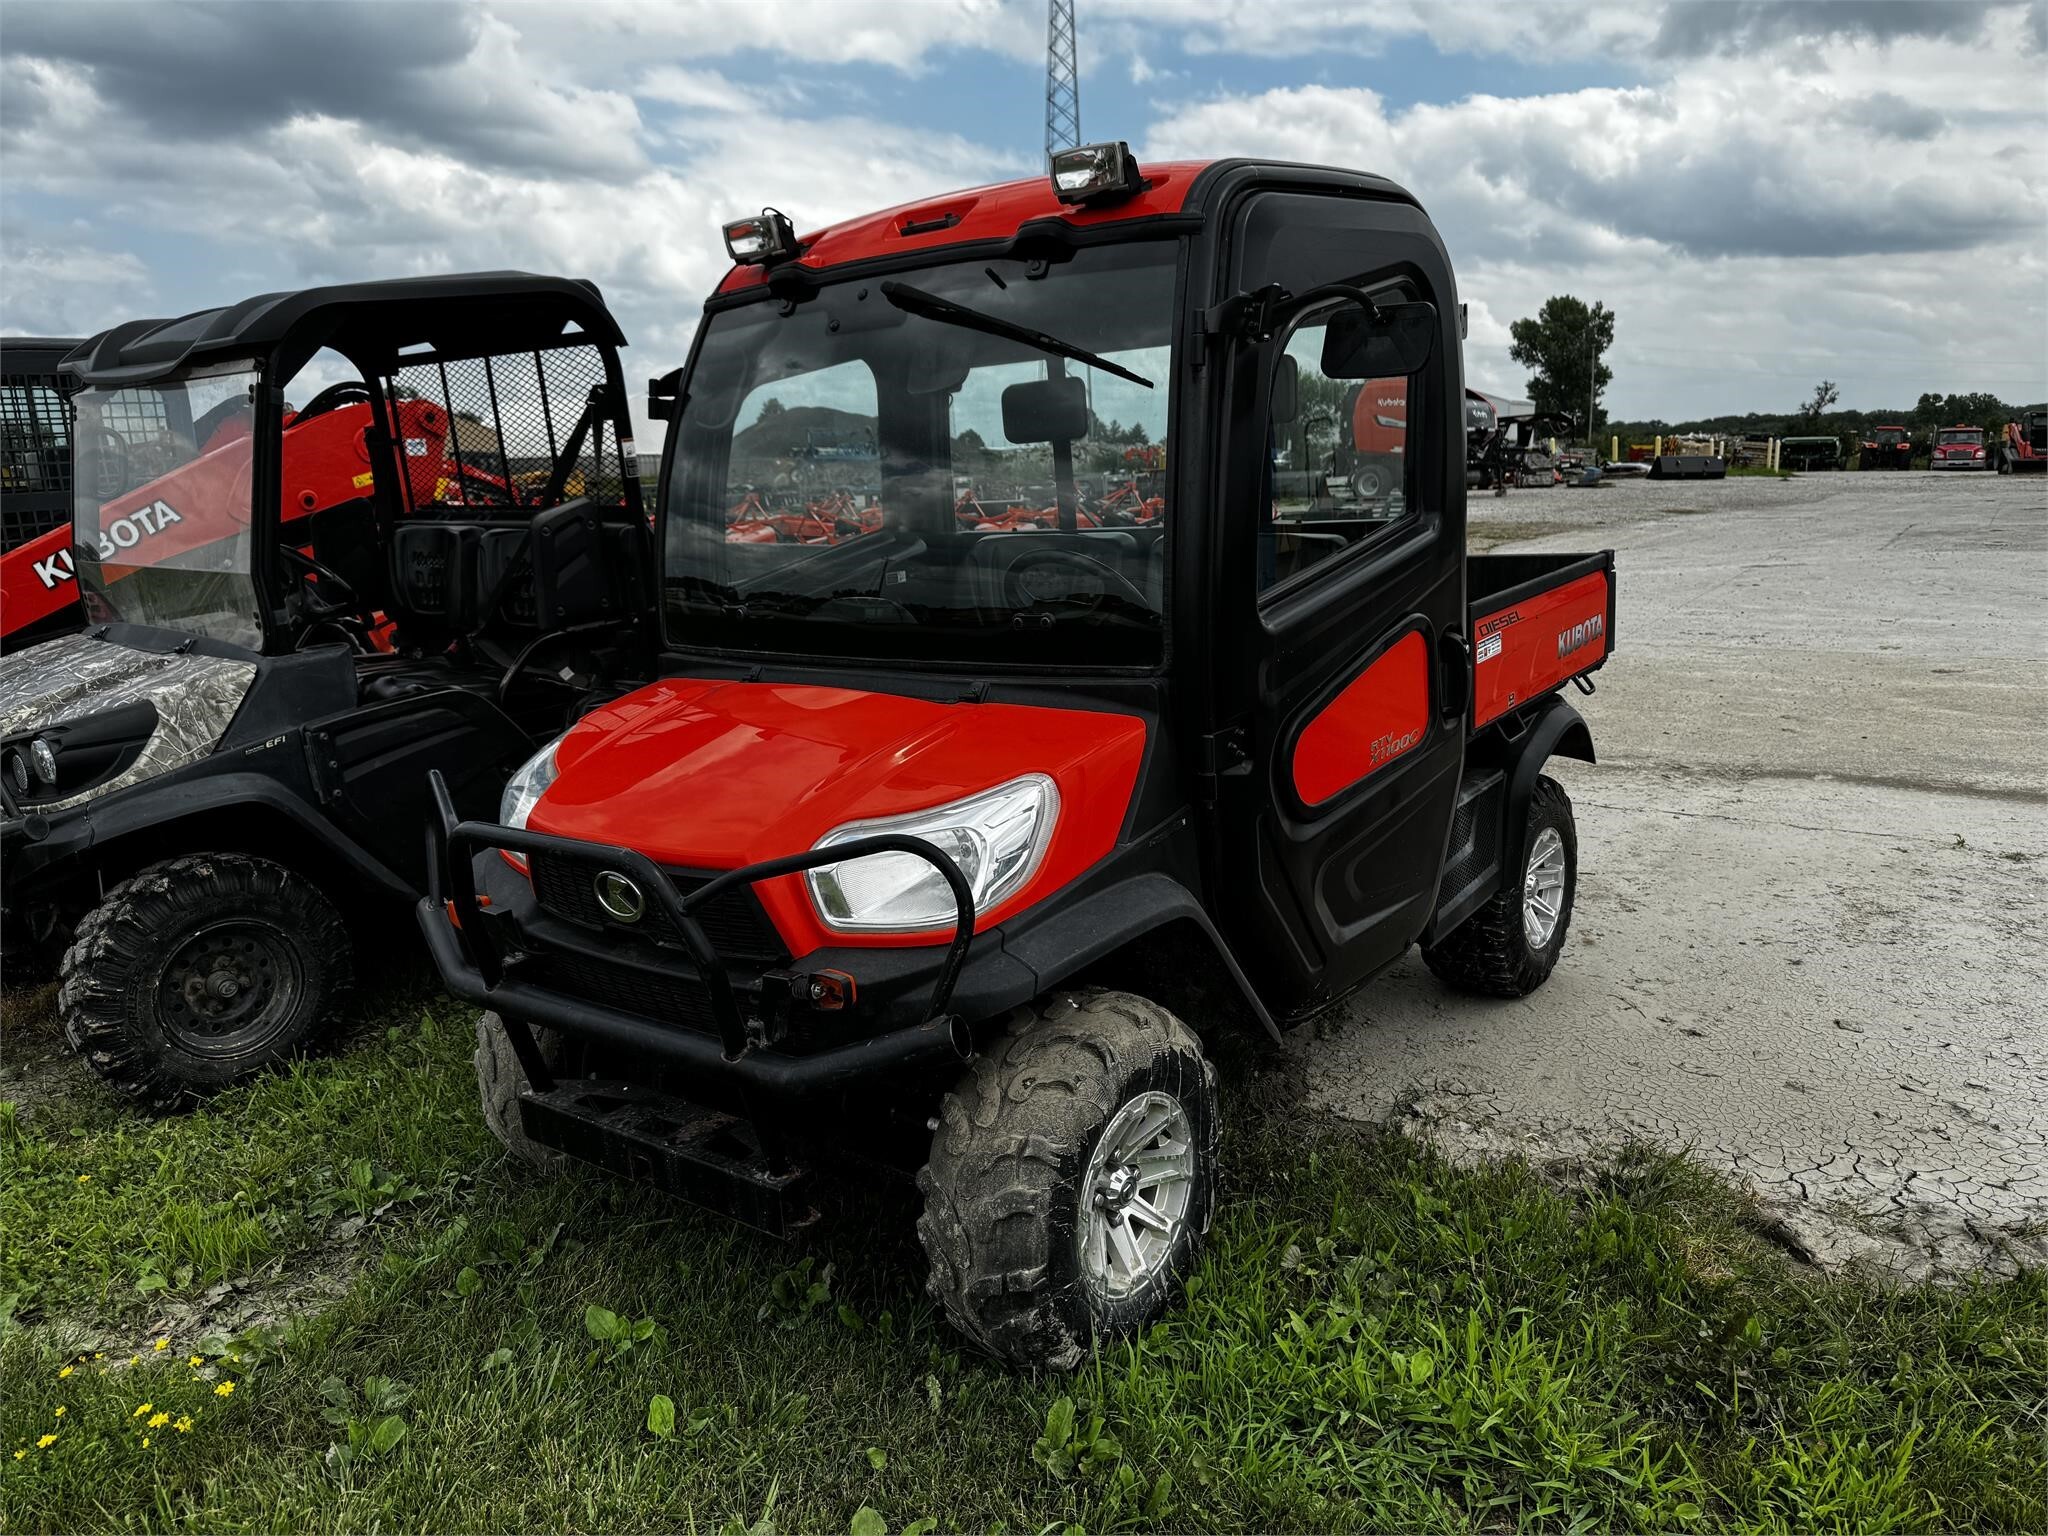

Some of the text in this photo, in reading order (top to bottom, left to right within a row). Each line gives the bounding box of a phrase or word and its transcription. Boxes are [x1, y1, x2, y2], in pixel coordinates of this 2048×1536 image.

[1478, 610, 1525, 637] DIESEL
[1557, 614, 1603, 659] KUBOTA
[266, 736, 286, 748] EFI
[1371, 731, 1394, 752] RTV
